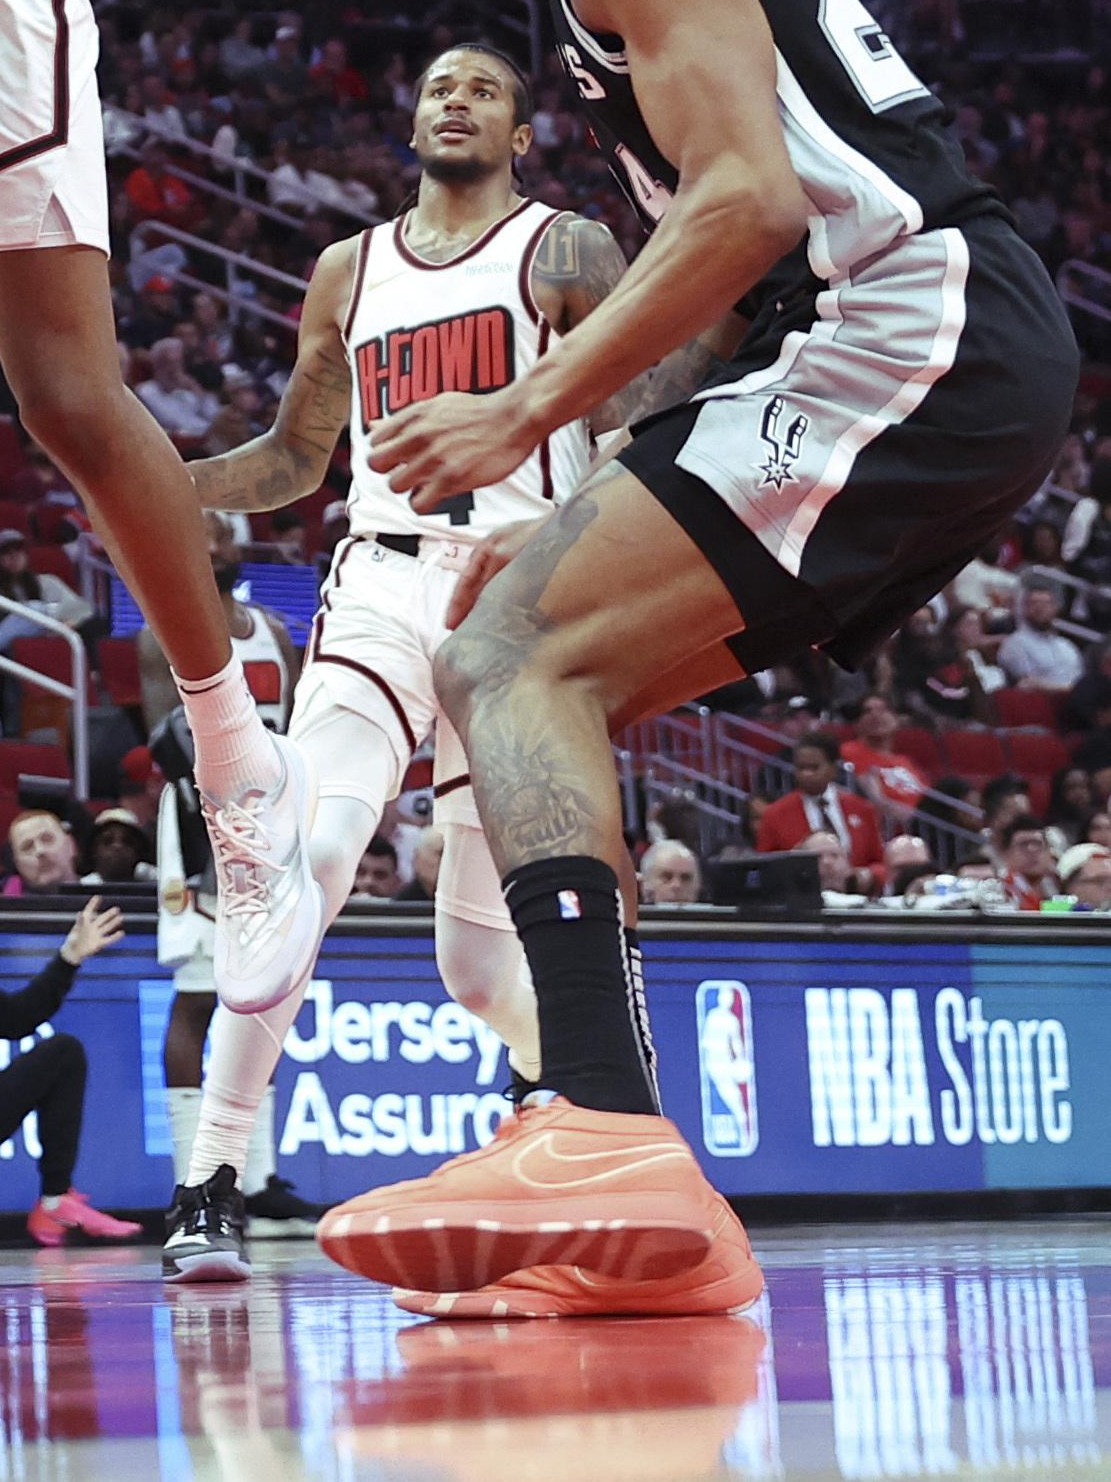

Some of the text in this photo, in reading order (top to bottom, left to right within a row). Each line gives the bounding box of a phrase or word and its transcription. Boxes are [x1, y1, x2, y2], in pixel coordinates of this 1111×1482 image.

[282, 979, 504, 1085] Jersey
[805, 986, 1074, 1148] NBA Store
